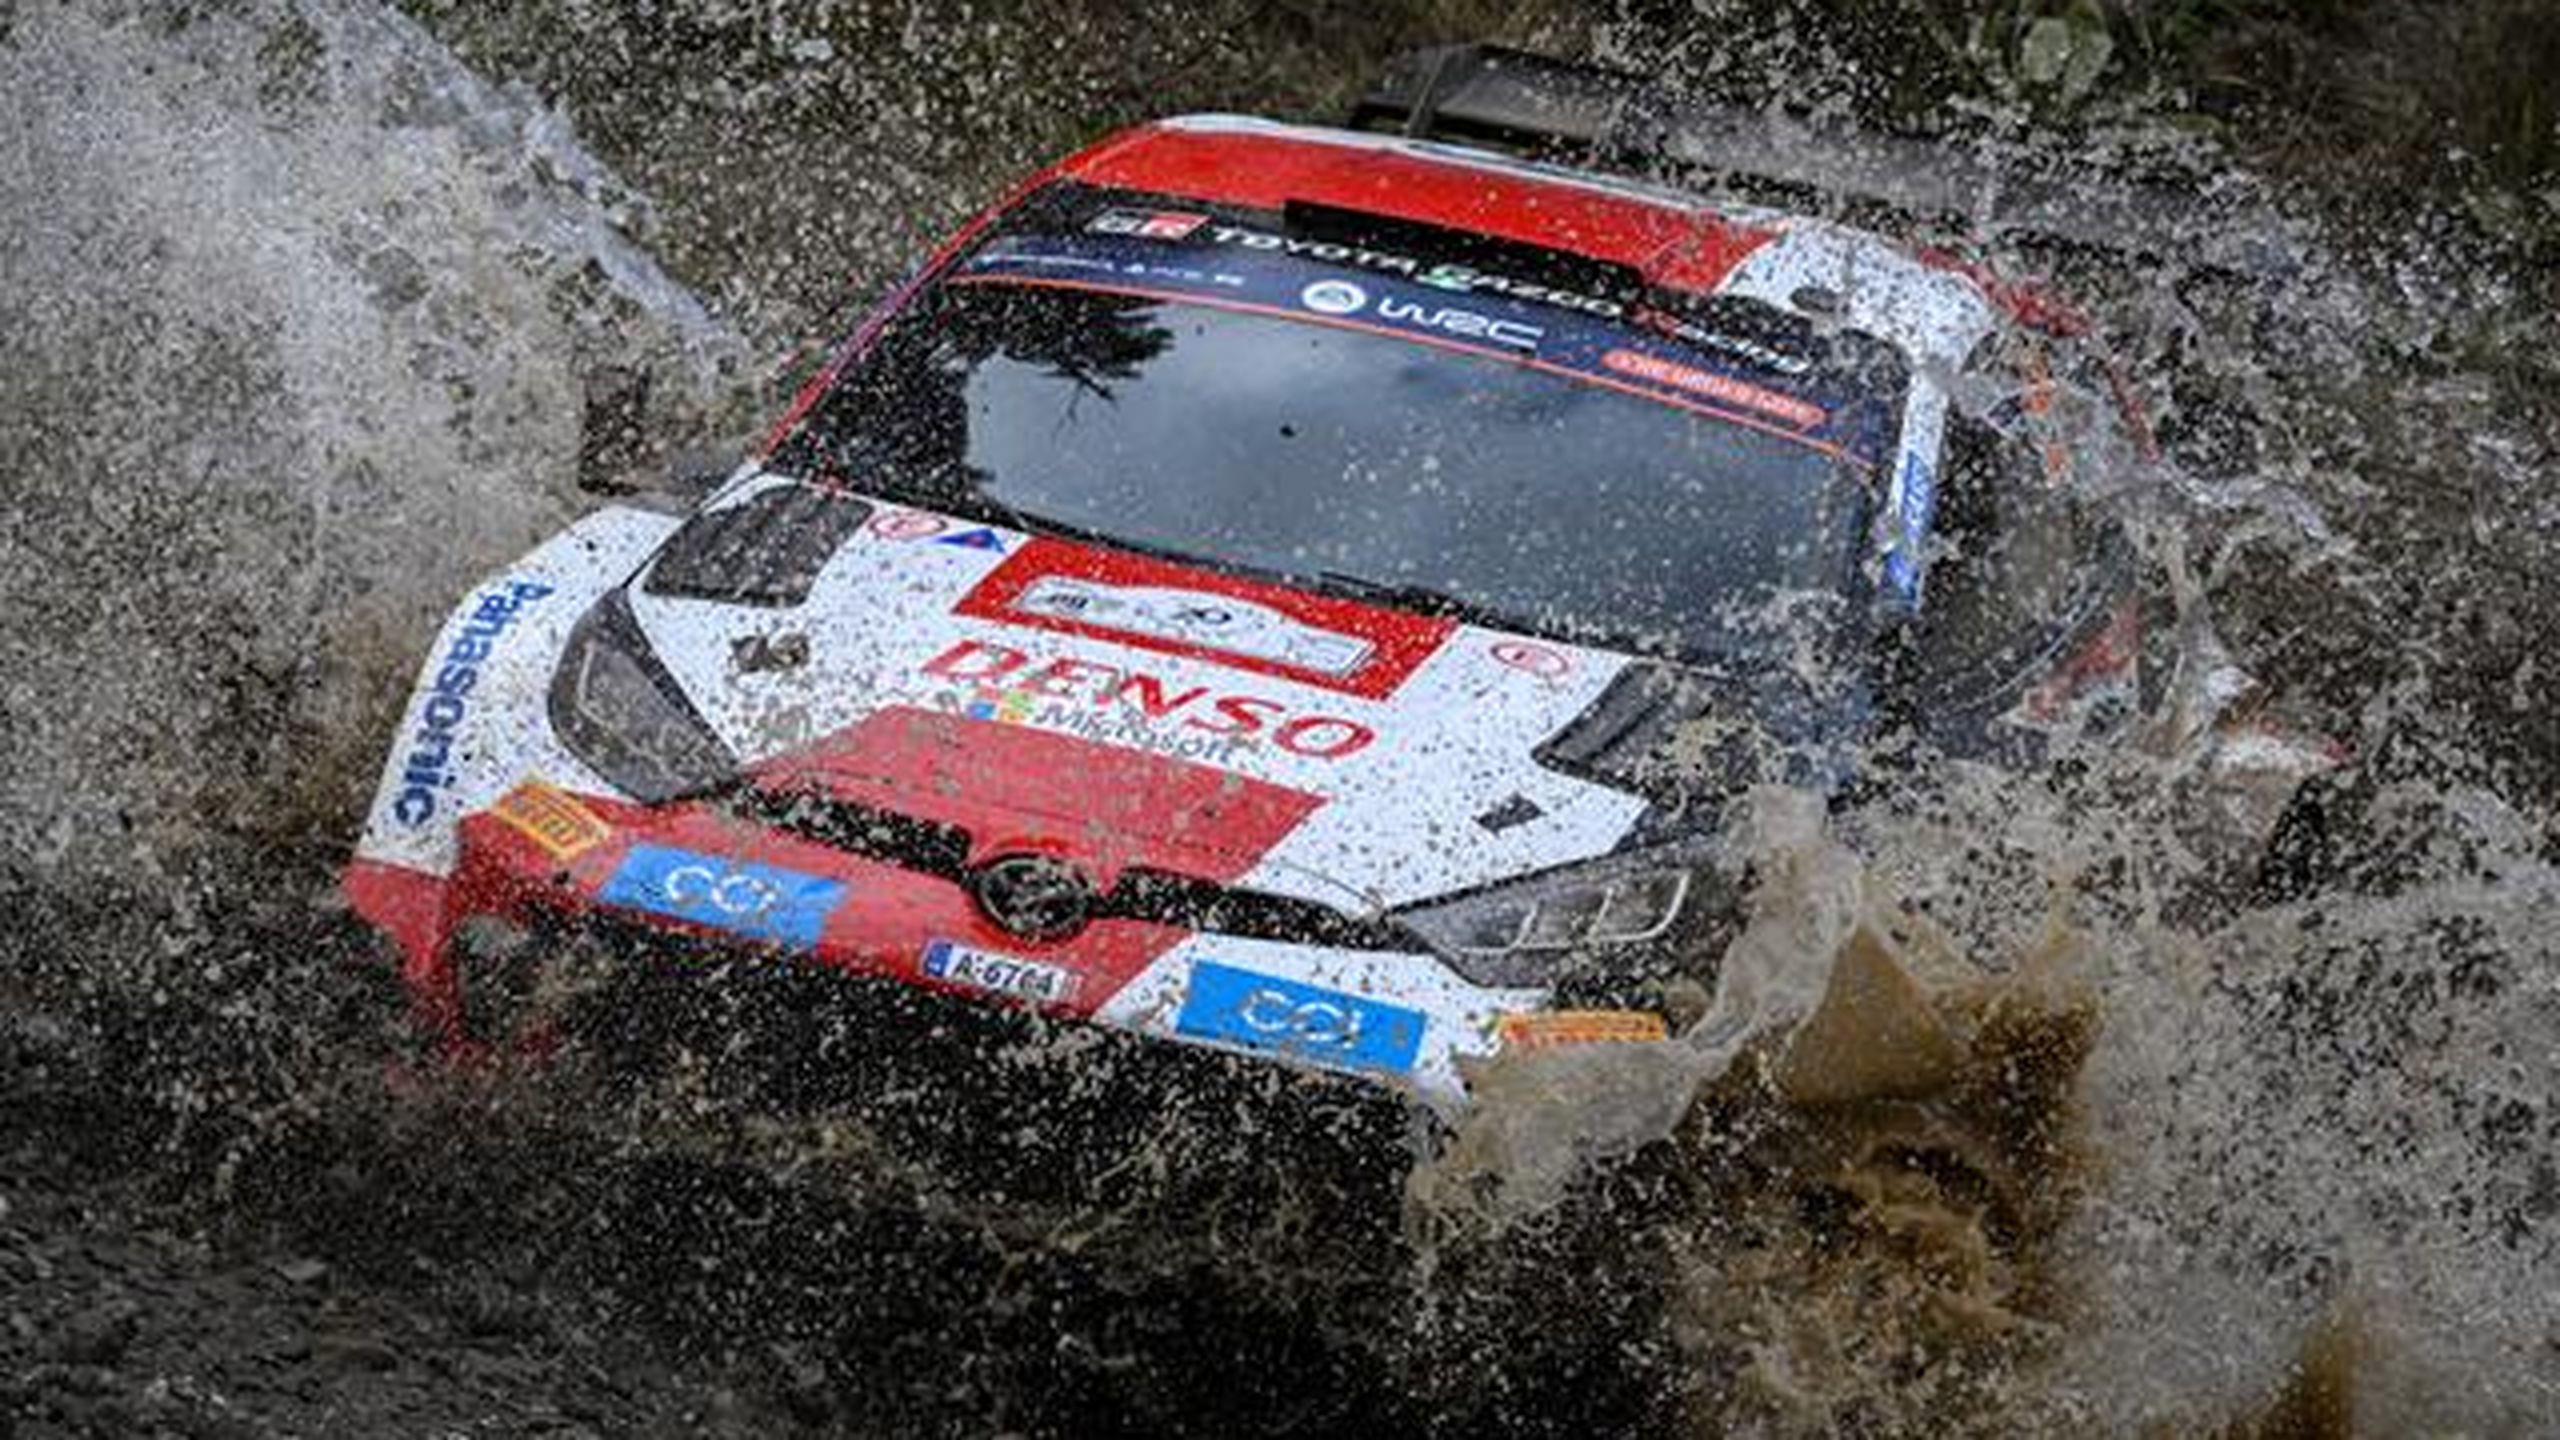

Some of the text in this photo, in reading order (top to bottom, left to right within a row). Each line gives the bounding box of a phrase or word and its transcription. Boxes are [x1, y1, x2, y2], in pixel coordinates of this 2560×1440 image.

[1213, 227, 1418, 277] TOYOTA
[1378, 297, 1545, 349] WRC
[394, 583, 555, 826] Panasonic
[919, 640, 1376, 758] DENSO
[1034, 703, 1236, 765] Microsoft
